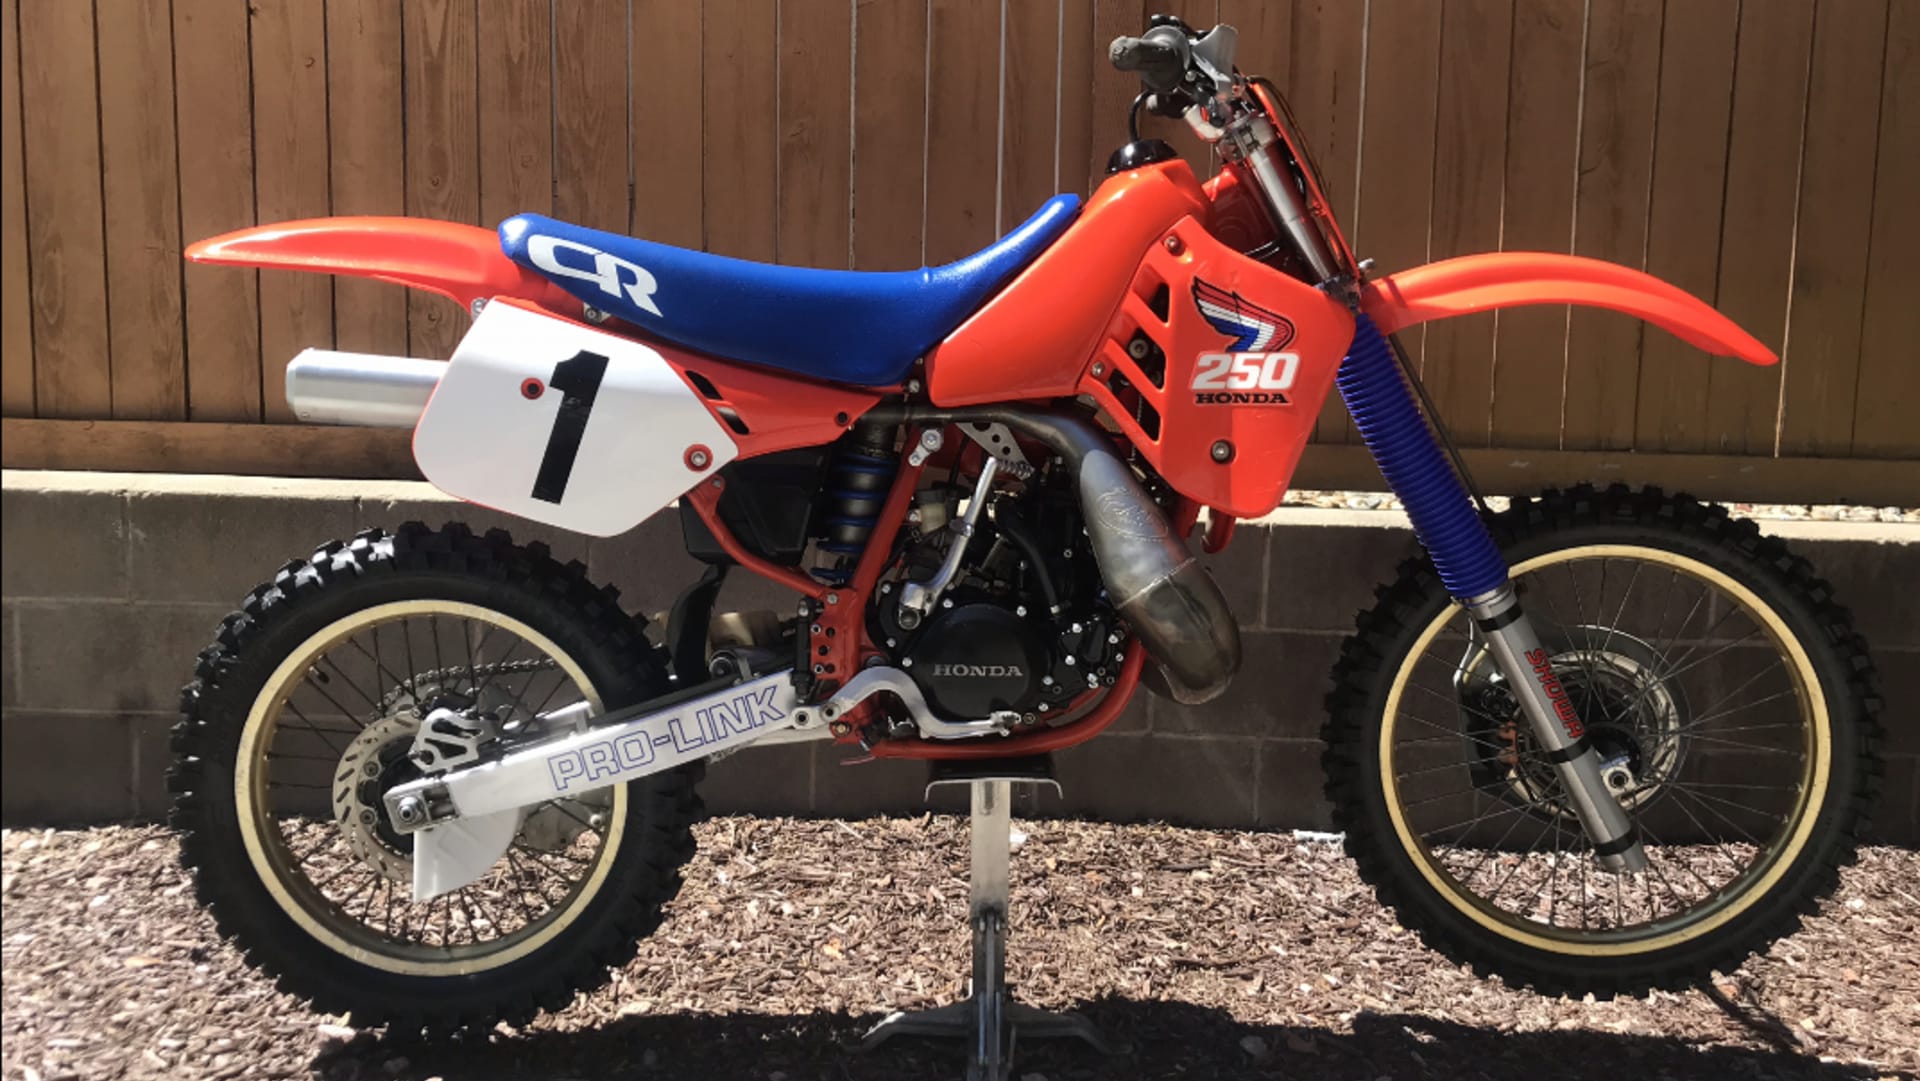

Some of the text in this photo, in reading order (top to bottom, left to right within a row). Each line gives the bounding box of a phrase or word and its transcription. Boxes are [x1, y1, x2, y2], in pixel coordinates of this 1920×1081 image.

[528, 235, 664, 317] CR
[1191, 353, 1299, 389] 250
[1195, 393, 1289, 404] HONDA
[531, 350, 609, 505] 1
[932, 664, 1023, 677] HONDA
[1525, 648, 1585, 739] SHOWA
[548, 684, 785, 790] PRO-LINK
